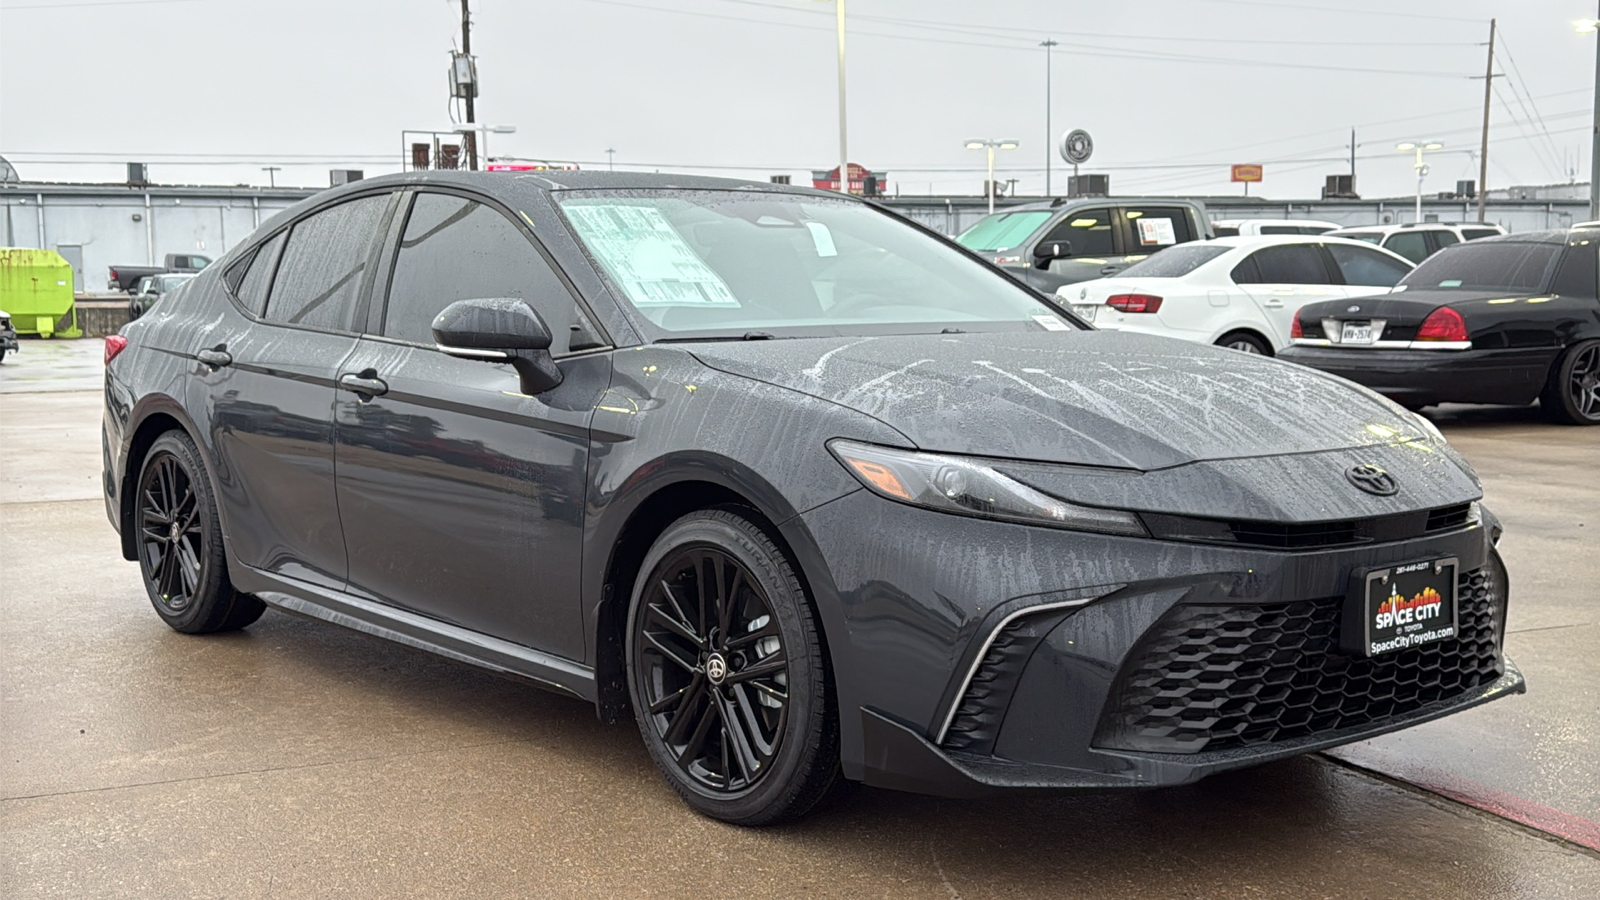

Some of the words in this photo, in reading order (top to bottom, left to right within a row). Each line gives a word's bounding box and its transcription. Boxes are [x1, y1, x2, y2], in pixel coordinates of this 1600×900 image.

[1375, 607, 1414, 629] SPACE
[1415, 602, 1442, 620] CITY
[1404, 623, 1424, 633] TOYOTA
[1371, 627, 1454, 654] SpaceCityToyota.com
